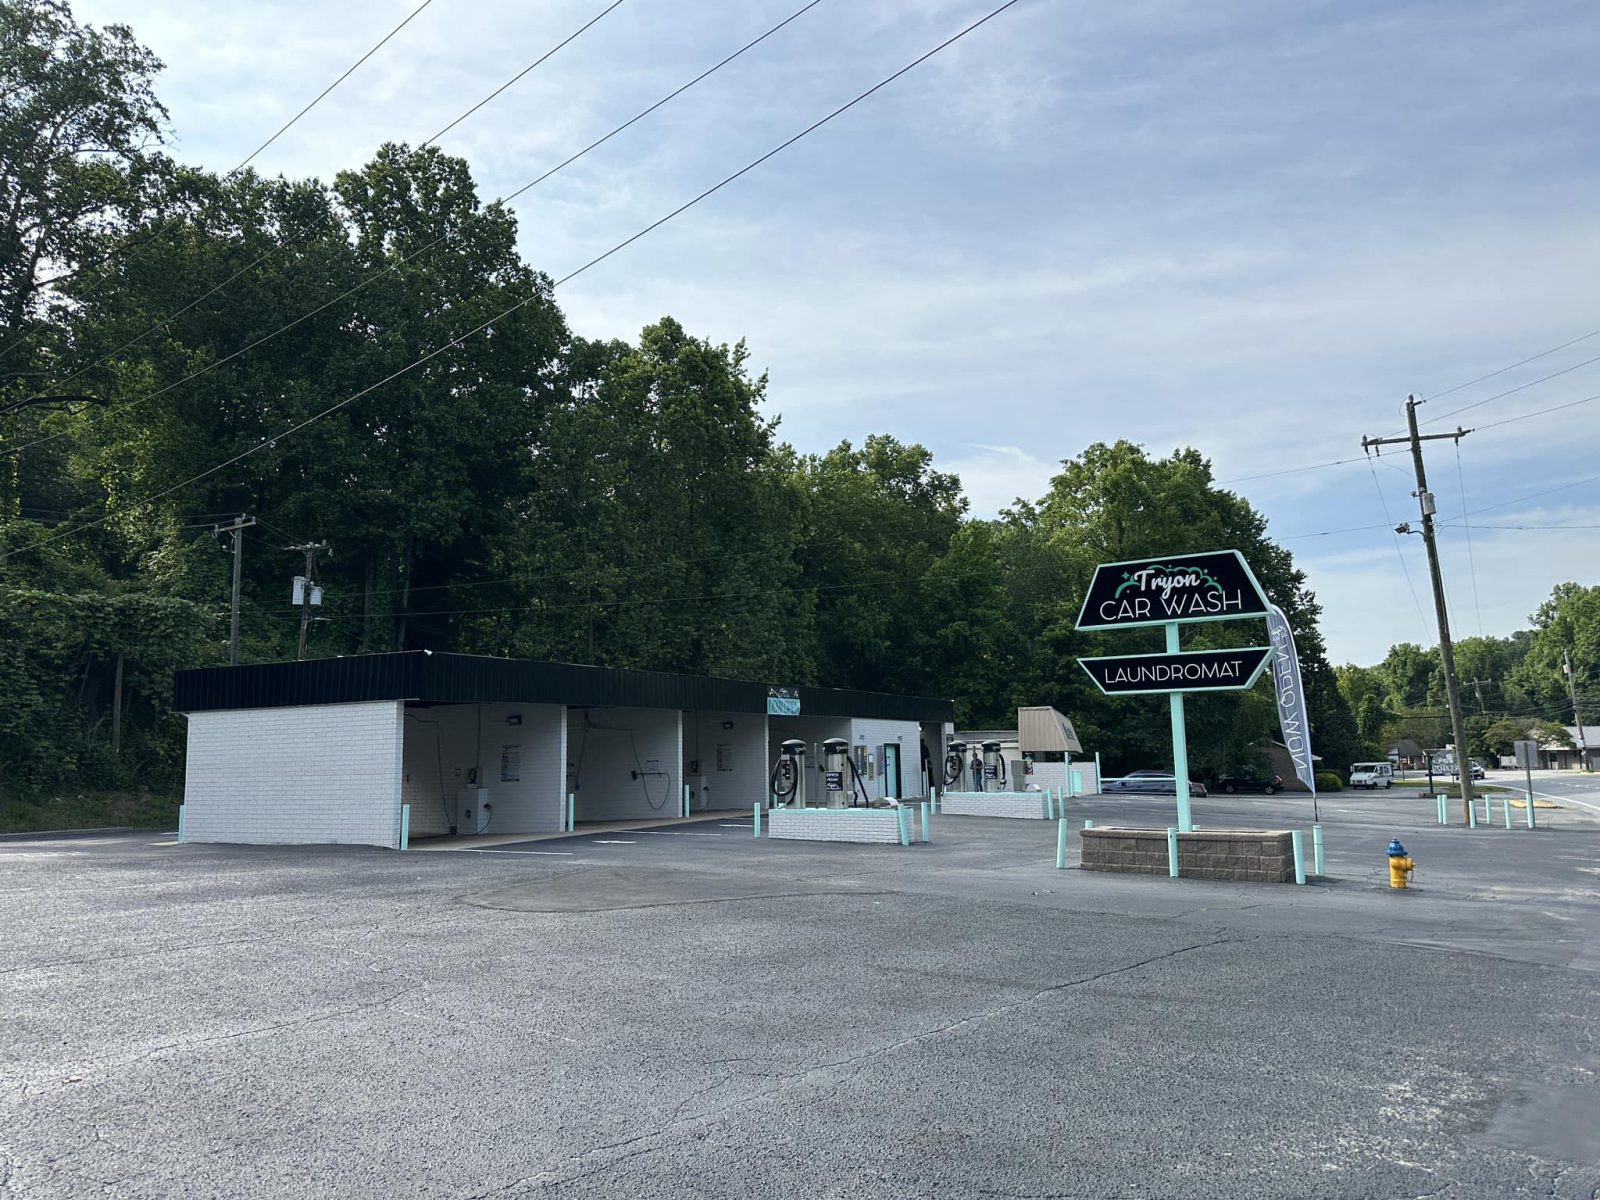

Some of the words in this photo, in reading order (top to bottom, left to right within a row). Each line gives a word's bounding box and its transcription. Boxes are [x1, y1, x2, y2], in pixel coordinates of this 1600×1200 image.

[1134, 569, 1201, 599] Tryon
[1099, 598, 1151, 621] CAR
[1159, 589, 1243, 616] WASH
[1104, 660, 1243, 684] LAUNDROMAT
